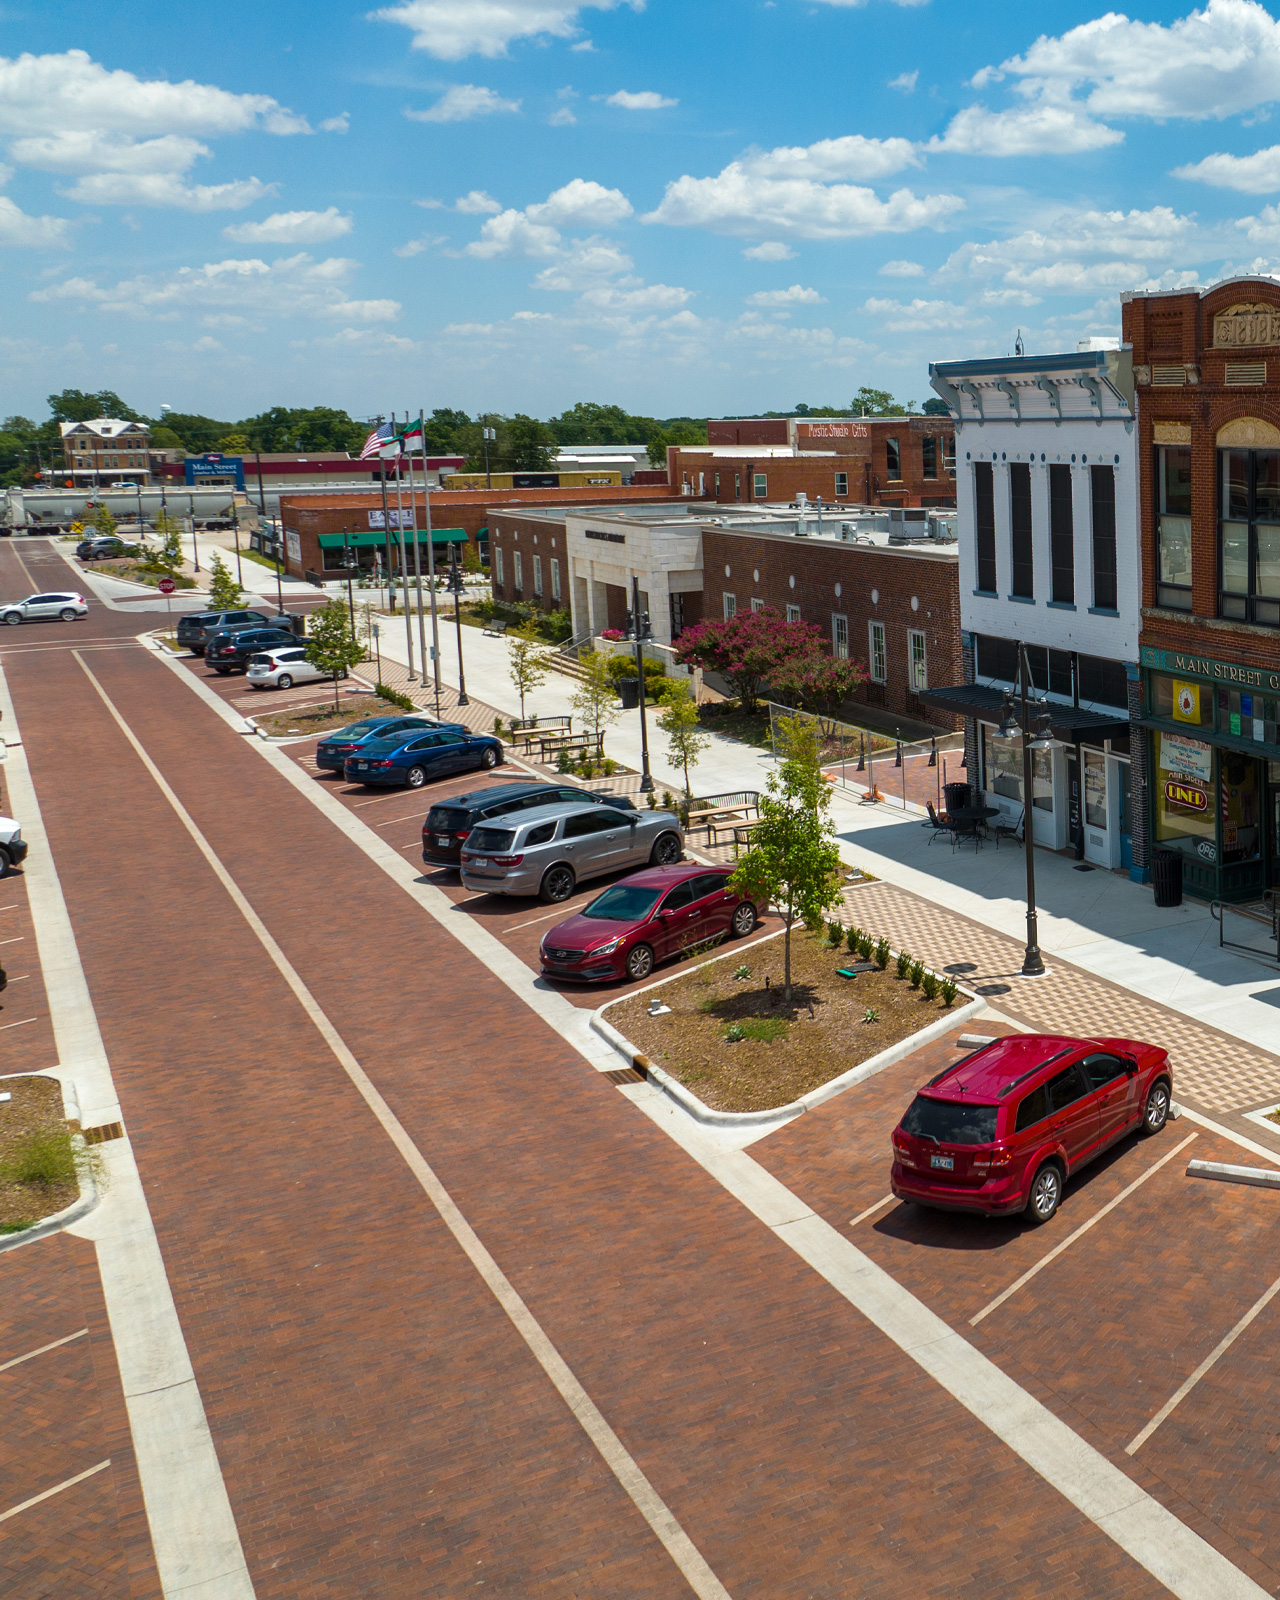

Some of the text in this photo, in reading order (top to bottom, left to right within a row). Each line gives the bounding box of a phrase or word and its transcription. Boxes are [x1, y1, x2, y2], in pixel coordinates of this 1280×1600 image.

[829, 423, 849, 438] Studio
[852, 423, 868, 438] Gifts
[369, 509, 413, 520] EAGE
[160, 582, 174, 590] STOP
[1174, 655, 1210, 676] MAIN
[1214, 663, 1262, 687] STREET
[1168, 784, 1204, 807] DINER
